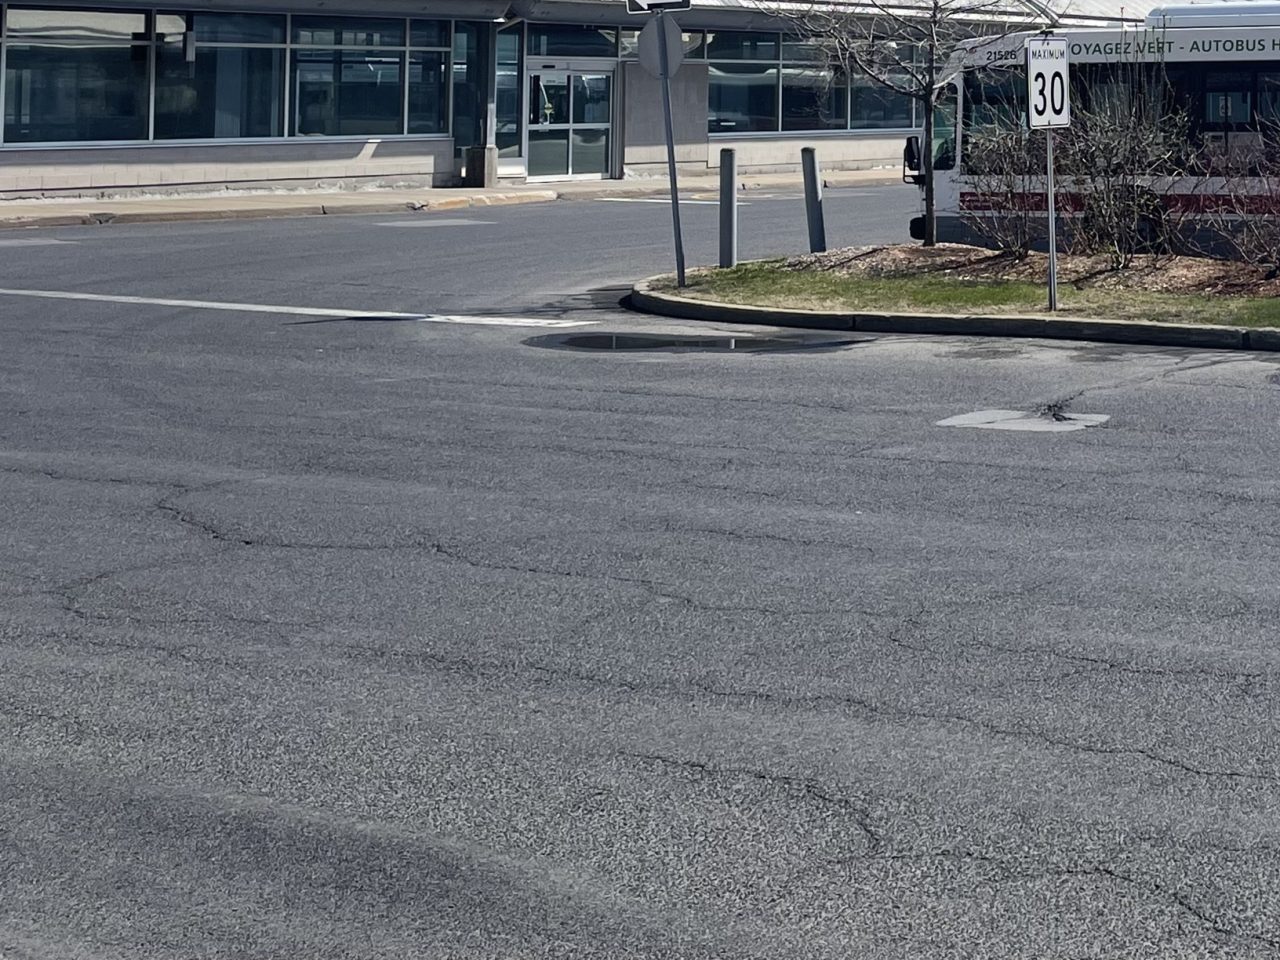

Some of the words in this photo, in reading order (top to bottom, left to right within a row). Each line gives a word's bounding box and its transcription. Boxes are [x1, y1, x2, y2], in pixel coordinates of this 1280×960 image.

[1031, 49, 1065, 60] MAXIMUM
[1067, 42, 1132, 56] OYAGEZ
[1136, 41, 1174, 54] VERT
[1189, 38, 1266, 53] AUTOBUS
[1034, 71, 1065, 117] 30
